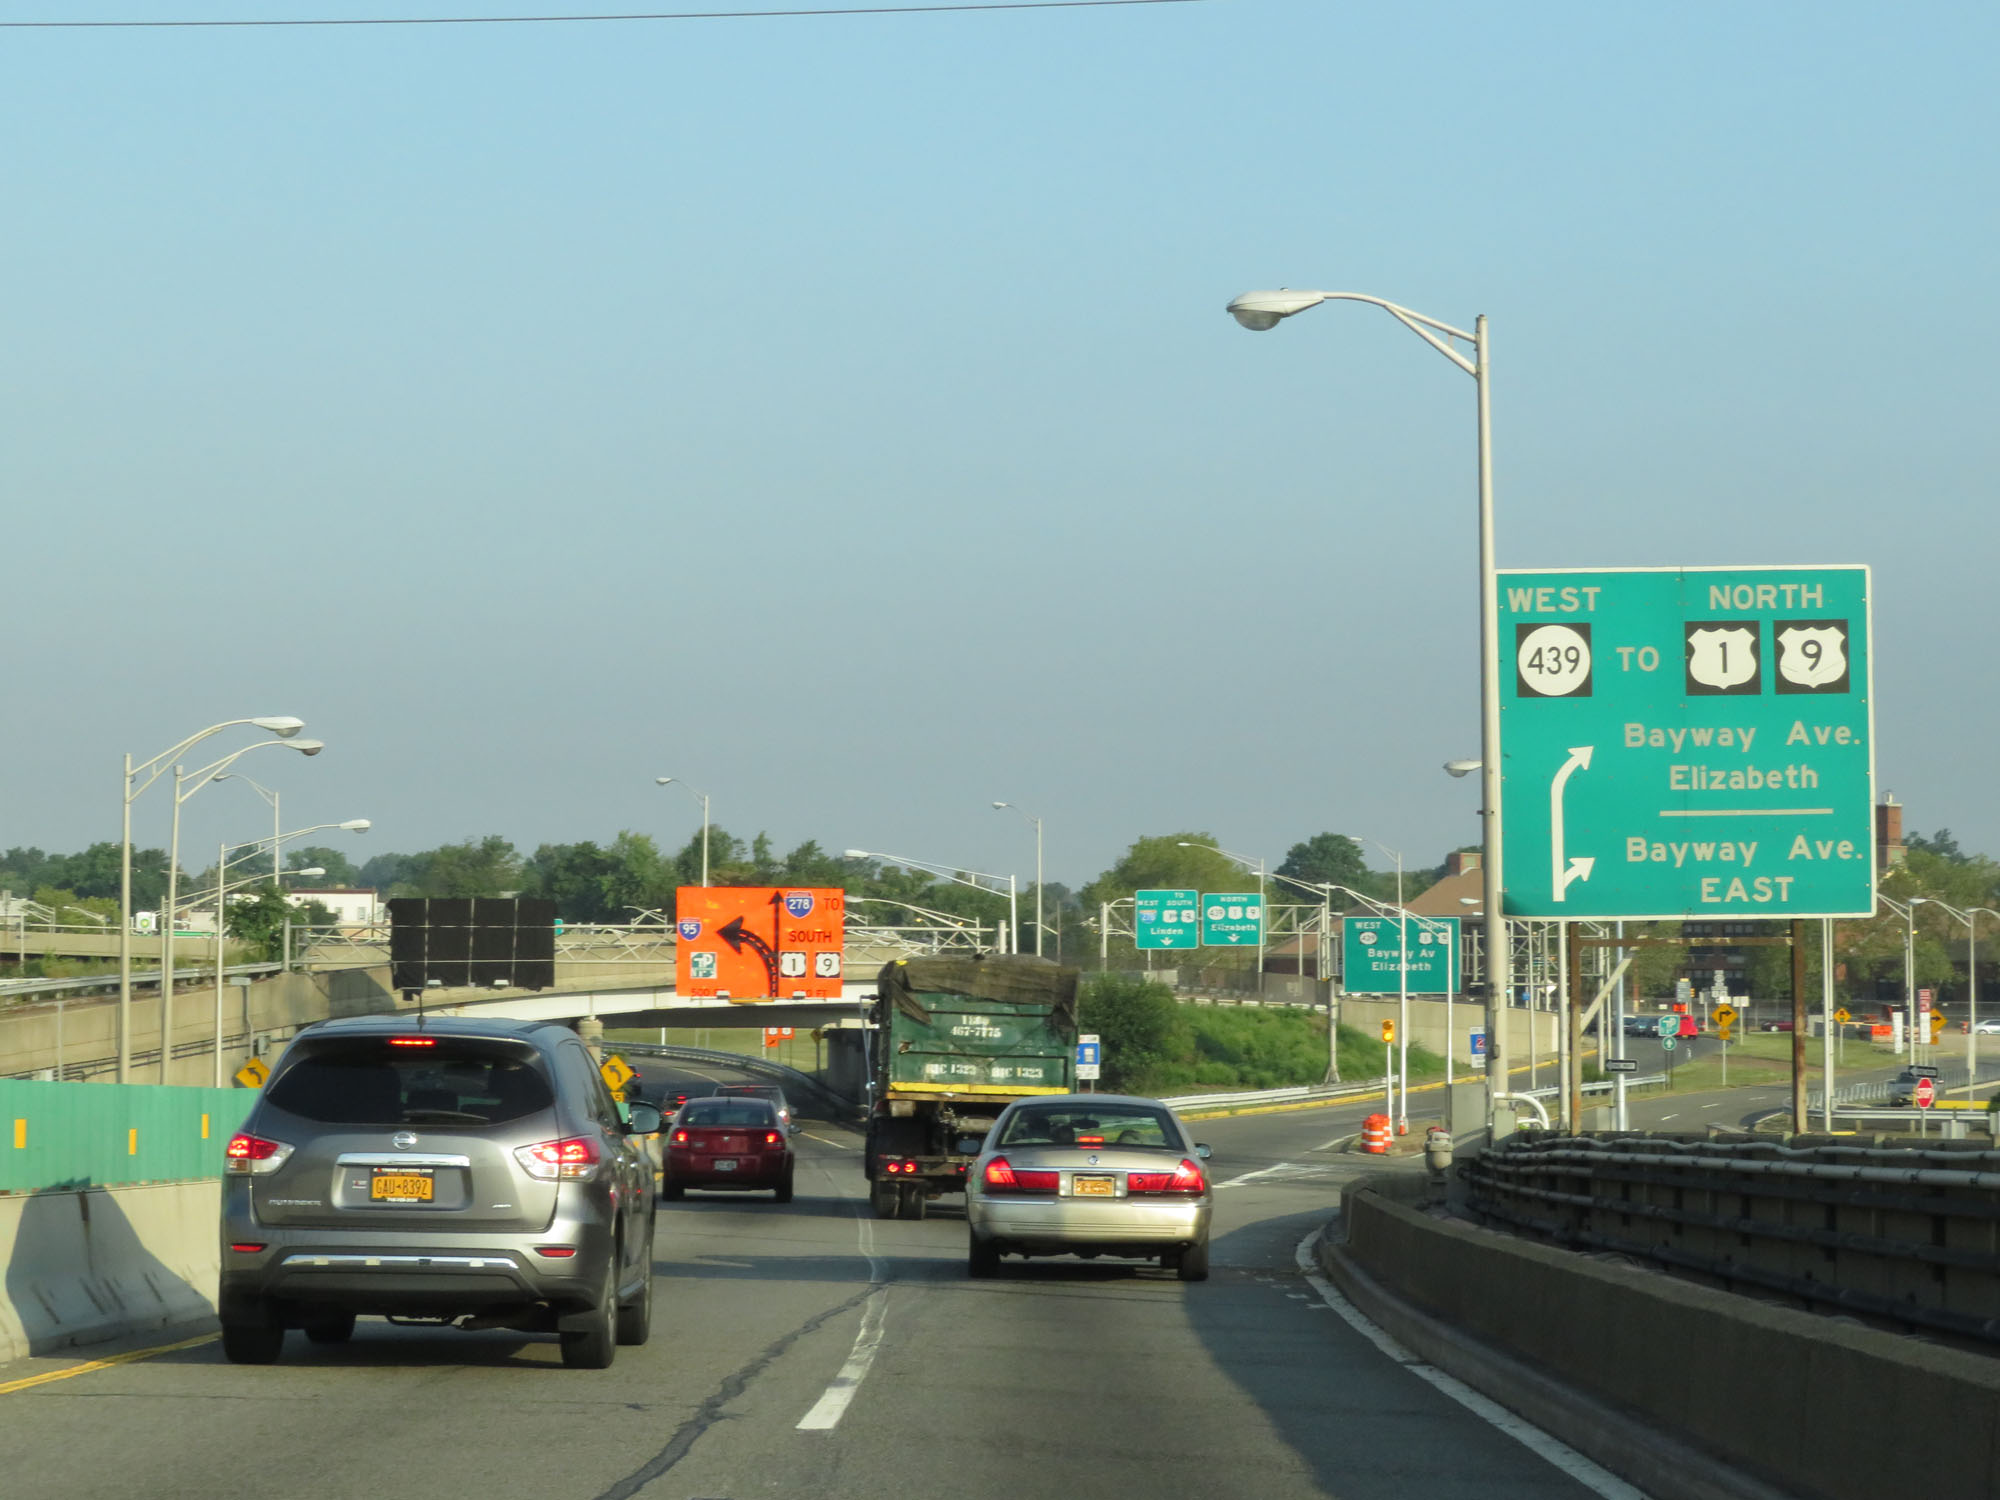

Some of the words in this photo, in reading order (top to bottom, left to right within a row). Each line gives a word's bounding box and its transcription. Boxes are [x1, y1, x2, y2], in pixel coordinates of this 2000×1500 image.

[1507, 587, 1601, 612] WEST
[1709, 583, 1823, 610] NORTH
[1527, 646, 1581, 675] 439
[1616, 646, 1659, 672] TO
[1719, 641, 1728, 674] 1
[1801, 639, 1823, 672] 9
[1623, 722, 1756, 754] Bayway
[1785, 720, 1861, 746] Ave.
[1669, 765, 1819, 791] Elizabeth
[1626, 837, 1758, 868] Bayway
[1788, 835, 1864, 860] Ave.
[1701, 877, 1794, 903] EAST
[789, 899, 810, 910] 278
[824, 898, 839, 910] TO
[682, 924, 697, 935] 95
[789, 931, 832, 943] SOUTH
[1150, 927, 1184, 935] Linden
[823, 958, 832, 971] 9
[1367, 948, 1414, 960] Baywy
